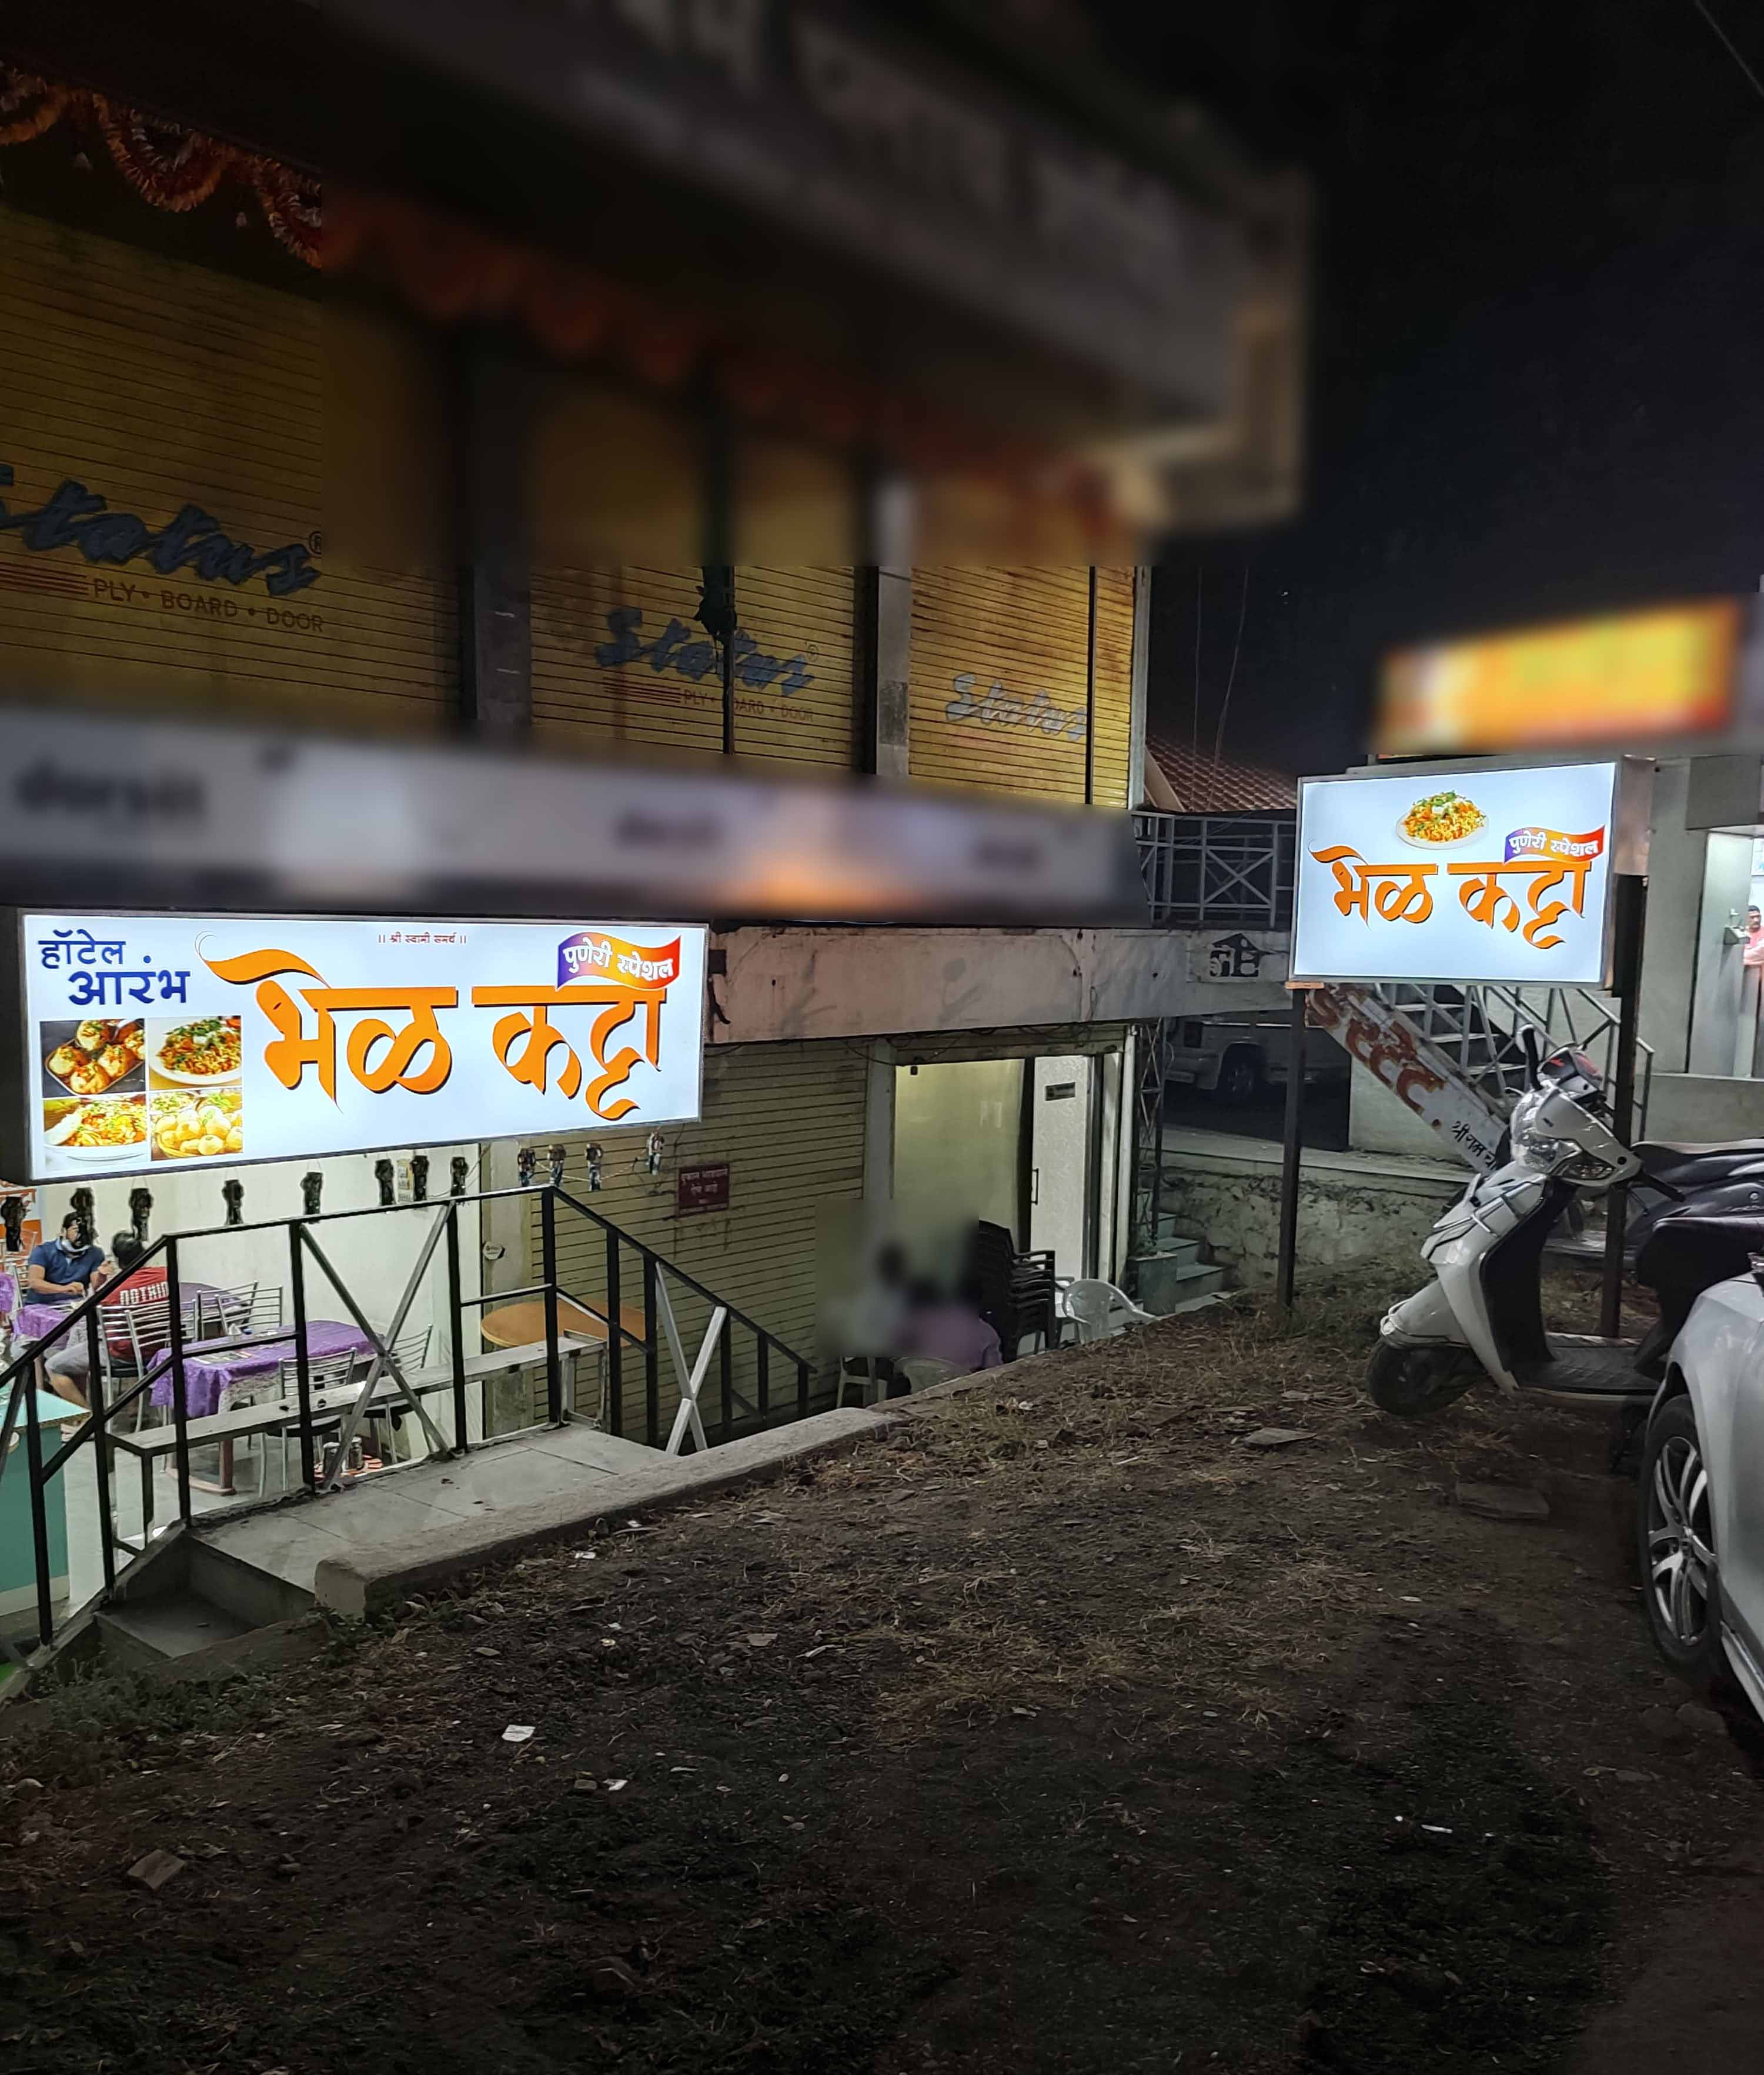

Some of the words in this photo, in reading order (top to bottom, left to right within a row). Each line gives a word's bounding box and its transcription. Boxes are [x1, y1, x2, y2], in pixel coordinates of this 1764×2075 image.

[93, 578, 137, 603] PLY
[161, 590, 238, 619] BOARD
[267, 607, 323, 633] DOOR
[781, 705, 813, 721] DOOR
[1508, 830, 1547, 853] पुणेरी
[1551, 837, 1598, 857] स्पेशल
[1308, 839, 1438, 930] भेळ
[39, 929, 126, 969] हॉटेल
[390, 932, 402, 943] श्री
[405, 932, 430, 943] स्वामी
[563, 936, 613, 974] पुणेरी
[617, 951, 674, 981] स्पेशल
[68, 955, 191, 1006] आरंभ
[198, 932, 457, 1113] भेळ
